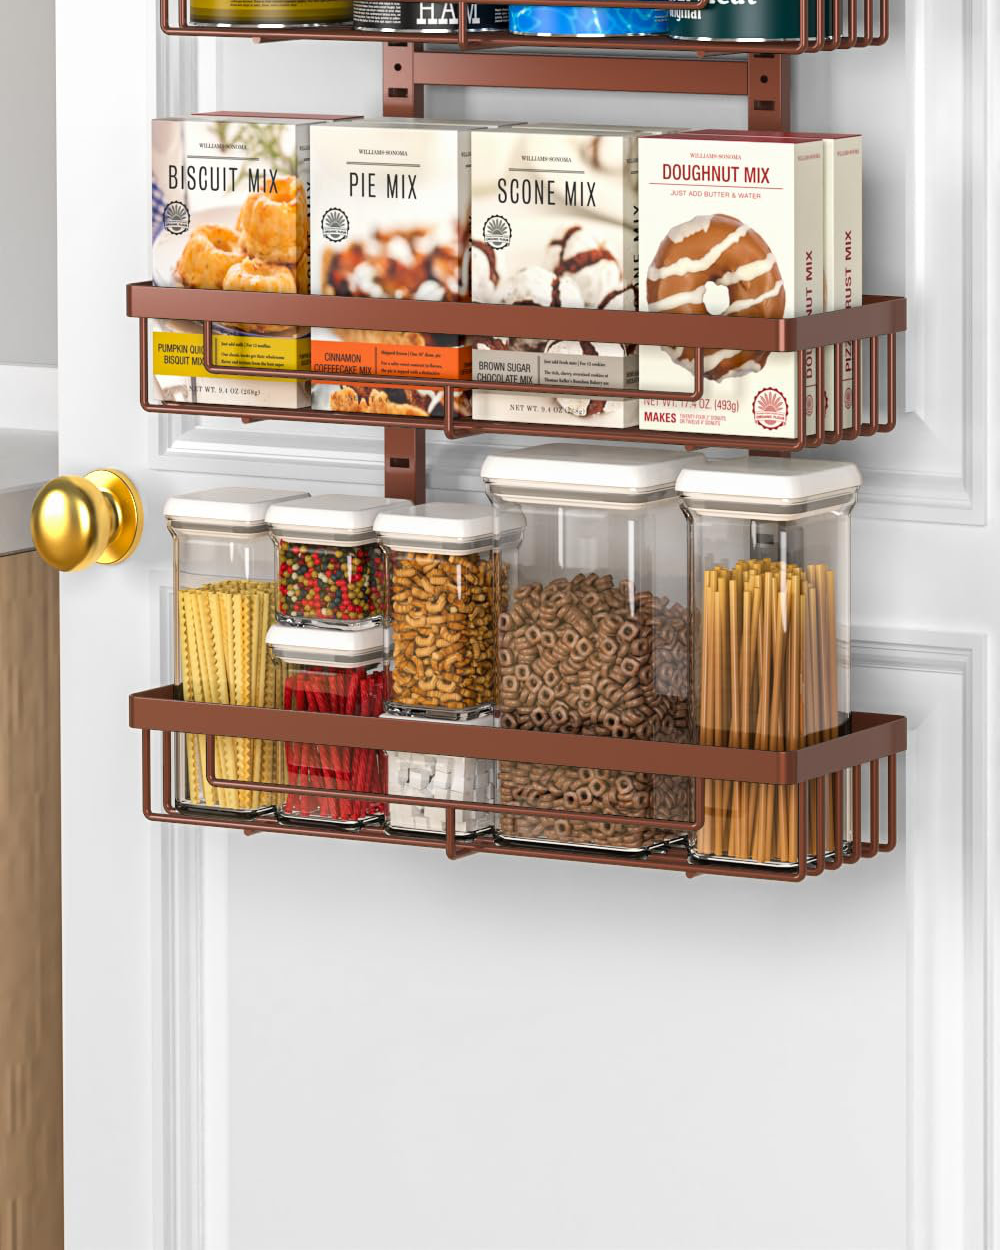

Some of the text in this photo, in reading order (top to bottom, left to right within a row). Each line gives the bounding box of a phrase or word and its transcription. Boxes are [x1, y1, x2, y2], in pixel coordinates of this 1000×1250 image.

[168, 165, 279, 194] BISCUIT MIX
[662, 163, 770, 184] DOUGHNUT MIX
[349, 172, 417, 199] PIE MIX
[498, 178, 596, 207] SCONE MIX
[805, 250, 814, 281] MIX
[157, 343, 188, 354] PUMPKIN
[163, 355, 204, 366] BISQUIT MIX
[324, 352, 361, 362] CINNAMON
[360, 365, 372, 374] MIX
[478, 361, 505, 372] BROWN
[507, 362, 531, 373] SUGAR
[477, 372, 533, 384] CHOCOLATE MIX
[509, 403, 524, 411] NET
[714, 400, 739, 413] (493g)
[644, 412, 676, 423] MAKES
